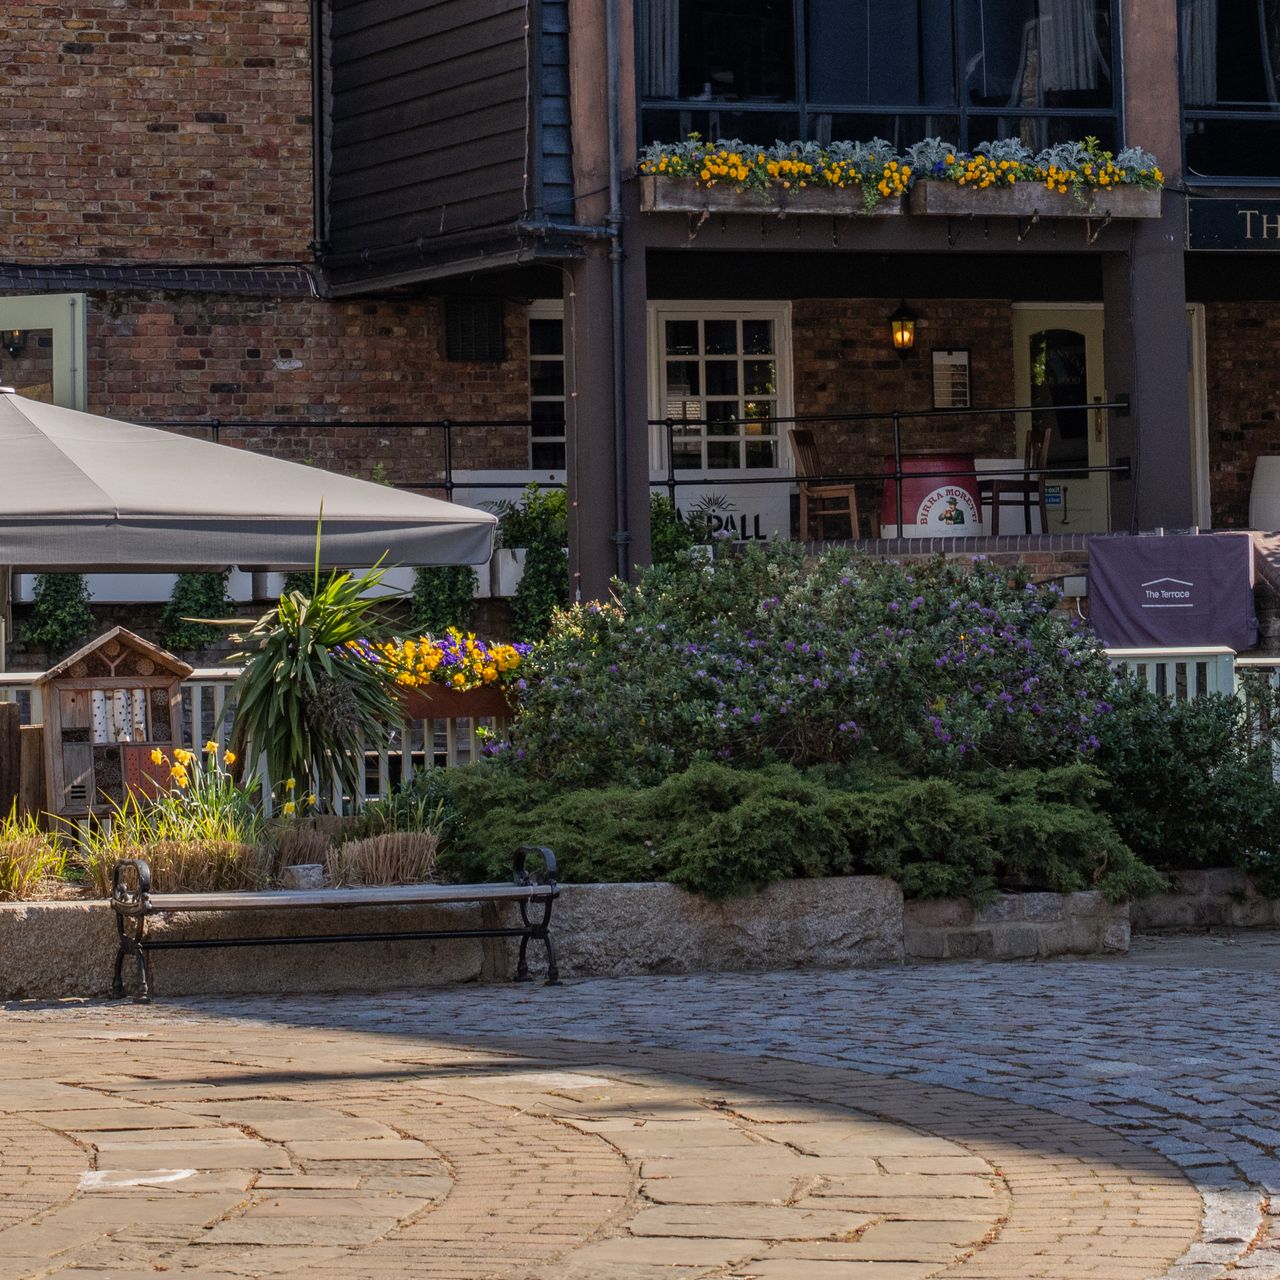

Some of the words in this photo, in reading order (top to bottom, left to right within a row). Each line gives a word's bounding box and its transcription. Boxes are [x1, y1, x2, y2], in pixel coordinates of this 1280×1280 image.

[920, 492, 945, 525] BIRRA
[945, 488, 977, 523] MORETTI
[1145, 590, 1160, 599] The
[1160, 590, 1190, 598] Terrace
